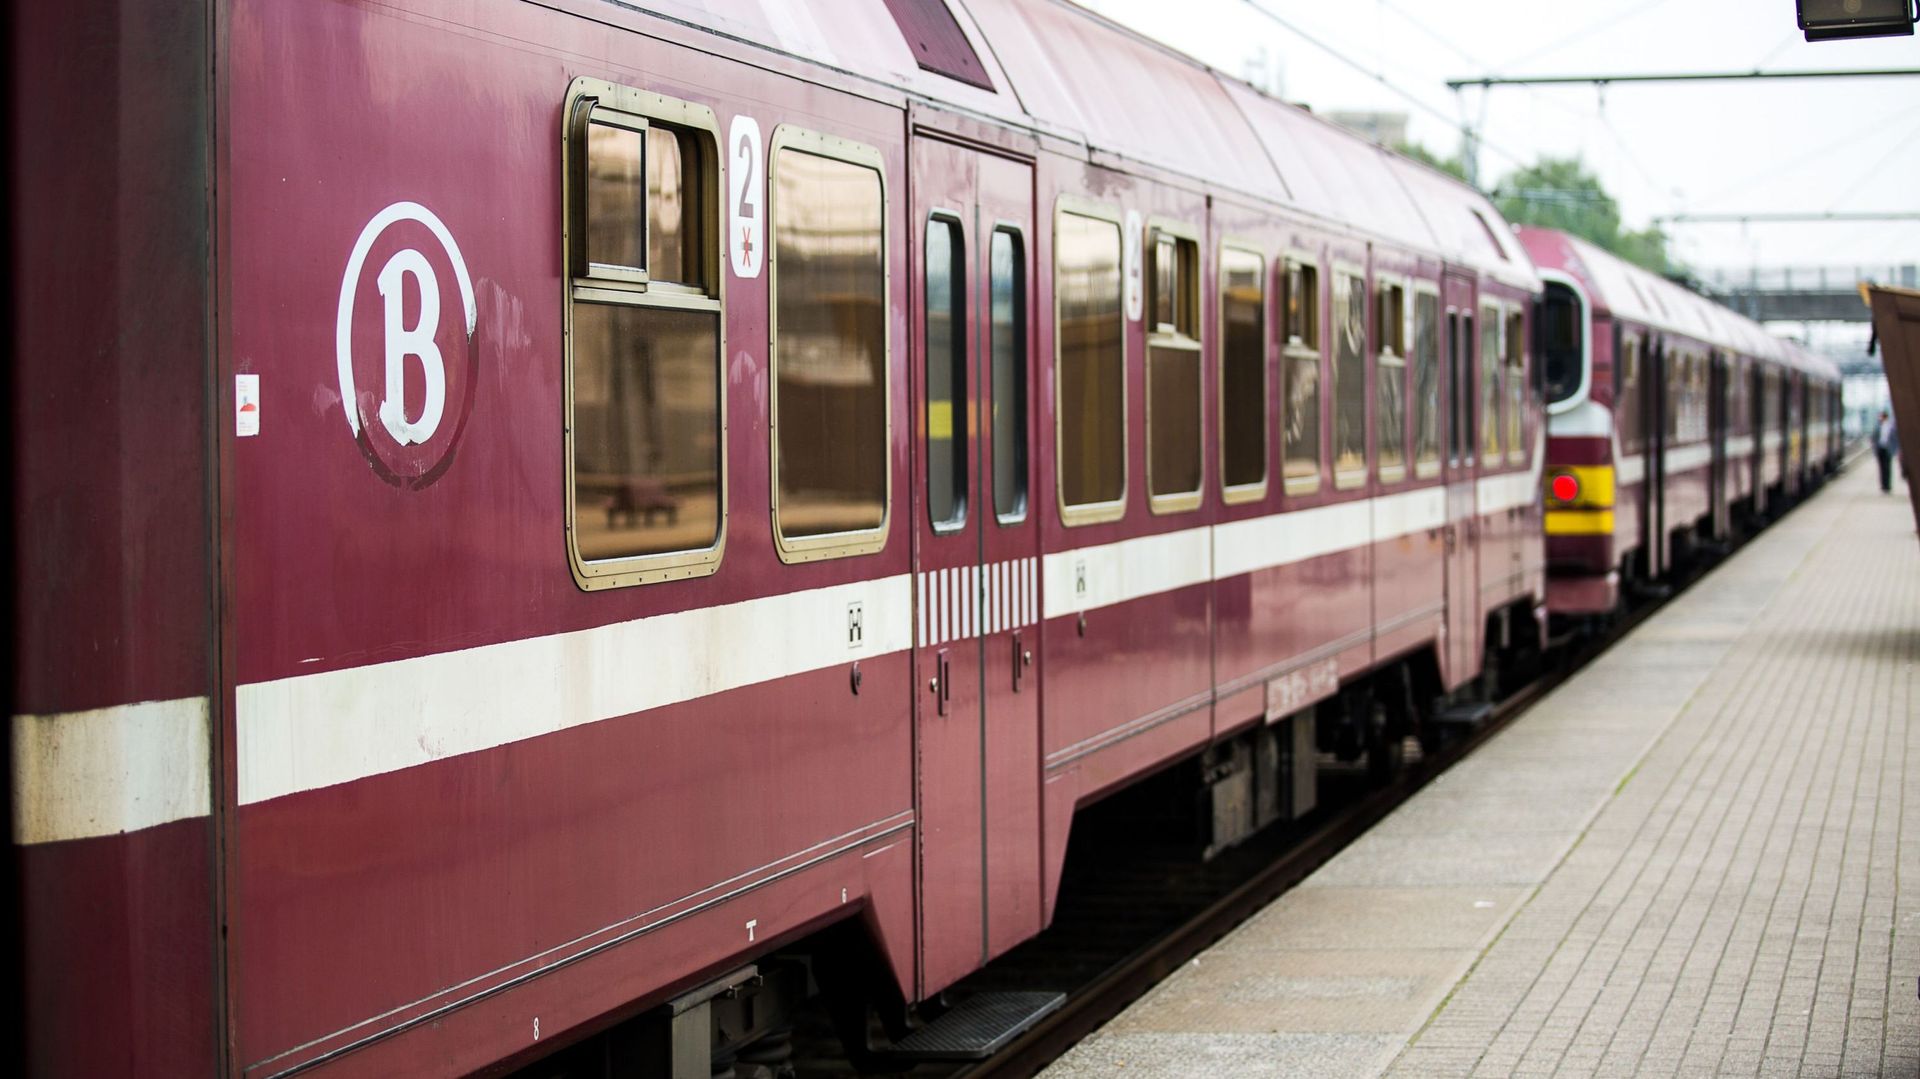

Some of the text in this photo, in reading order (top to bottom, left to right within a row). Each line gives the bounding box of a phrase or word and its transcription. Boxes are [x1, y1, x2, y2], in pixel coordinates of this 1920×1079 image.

[738, 133, 754, 219] 2
[376, 248, 446, 447] B
[746, 919, 757, 941] T
[533, 1016, 540, 1041] 8
